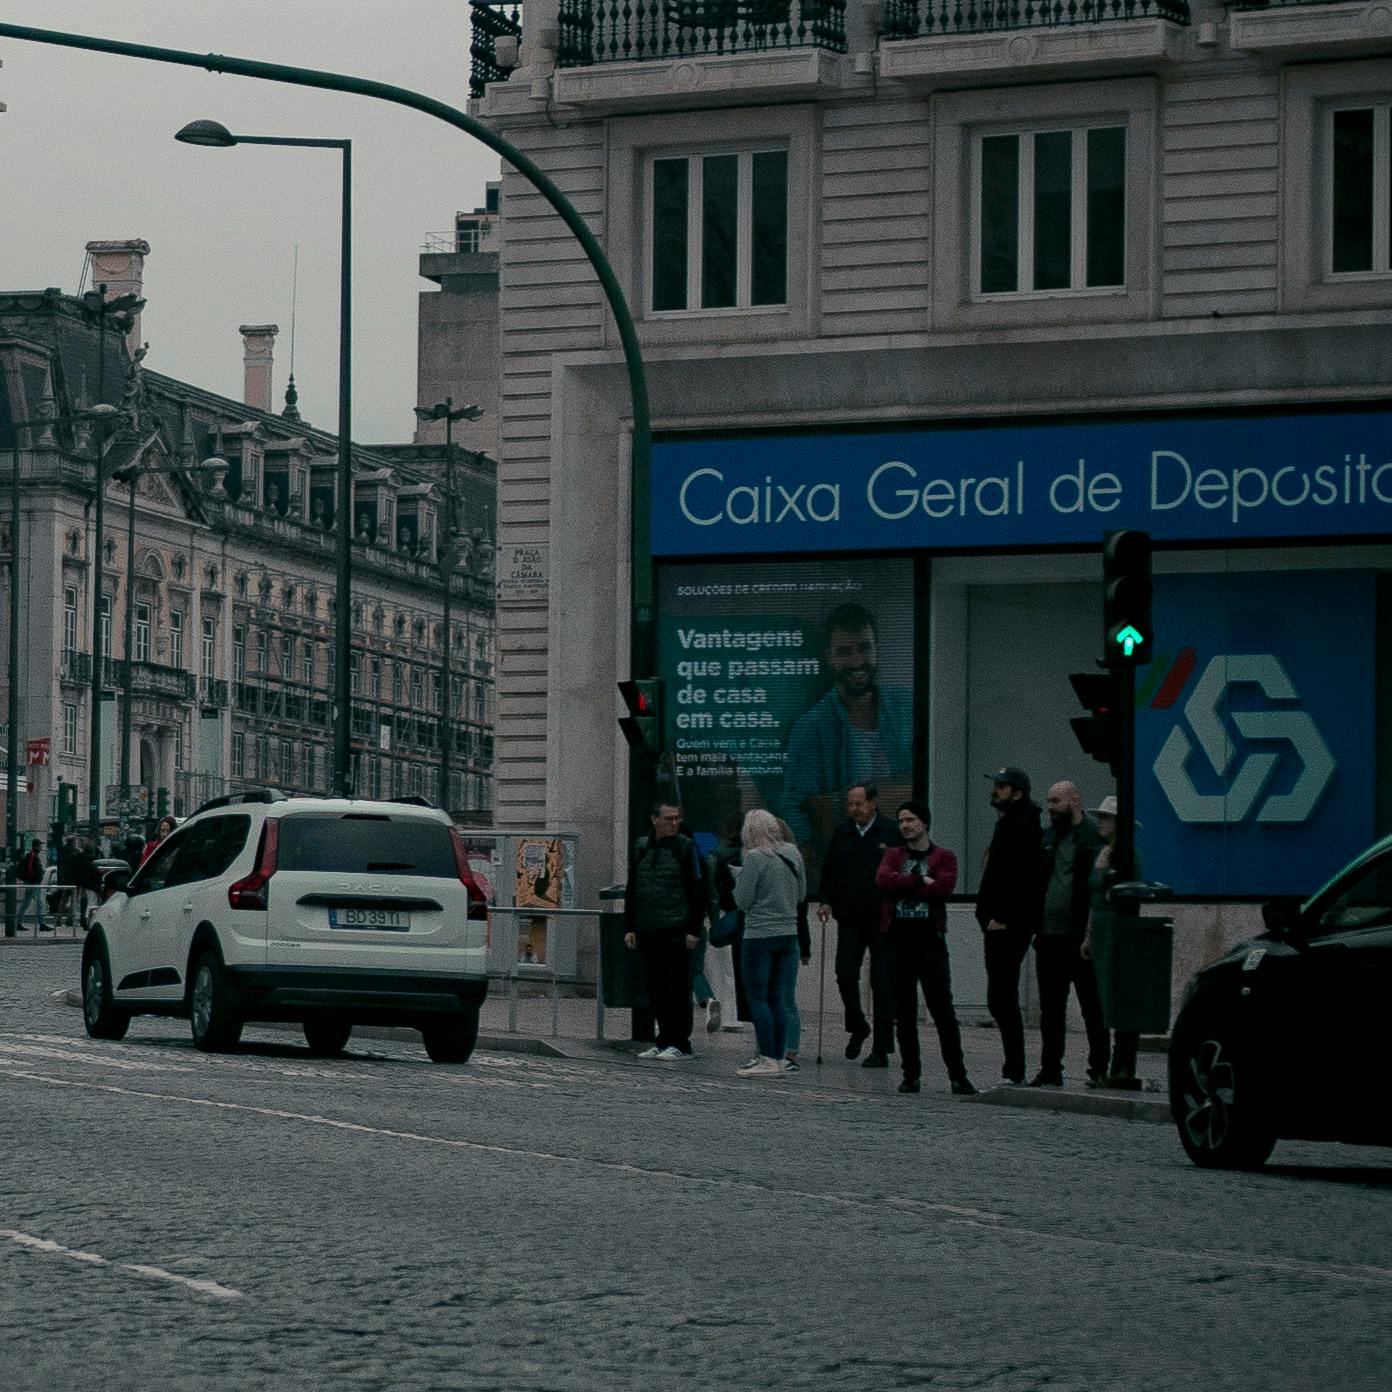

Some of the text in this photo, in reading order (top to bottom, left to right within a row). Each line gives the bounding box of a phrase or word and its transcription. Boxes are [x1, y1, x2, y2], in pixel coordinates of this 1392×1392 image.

[679, 467, 841, 526] Caixa
[866, 460, 1025, 521] Geral
[1049, 458, 1123, 514] de
[677, 628, 805, 651] Vantagens
[676, 658, 820, 681] que passam
[676, 683, 768, 705] de casa
[676, 711, 780, 729] em casa.
